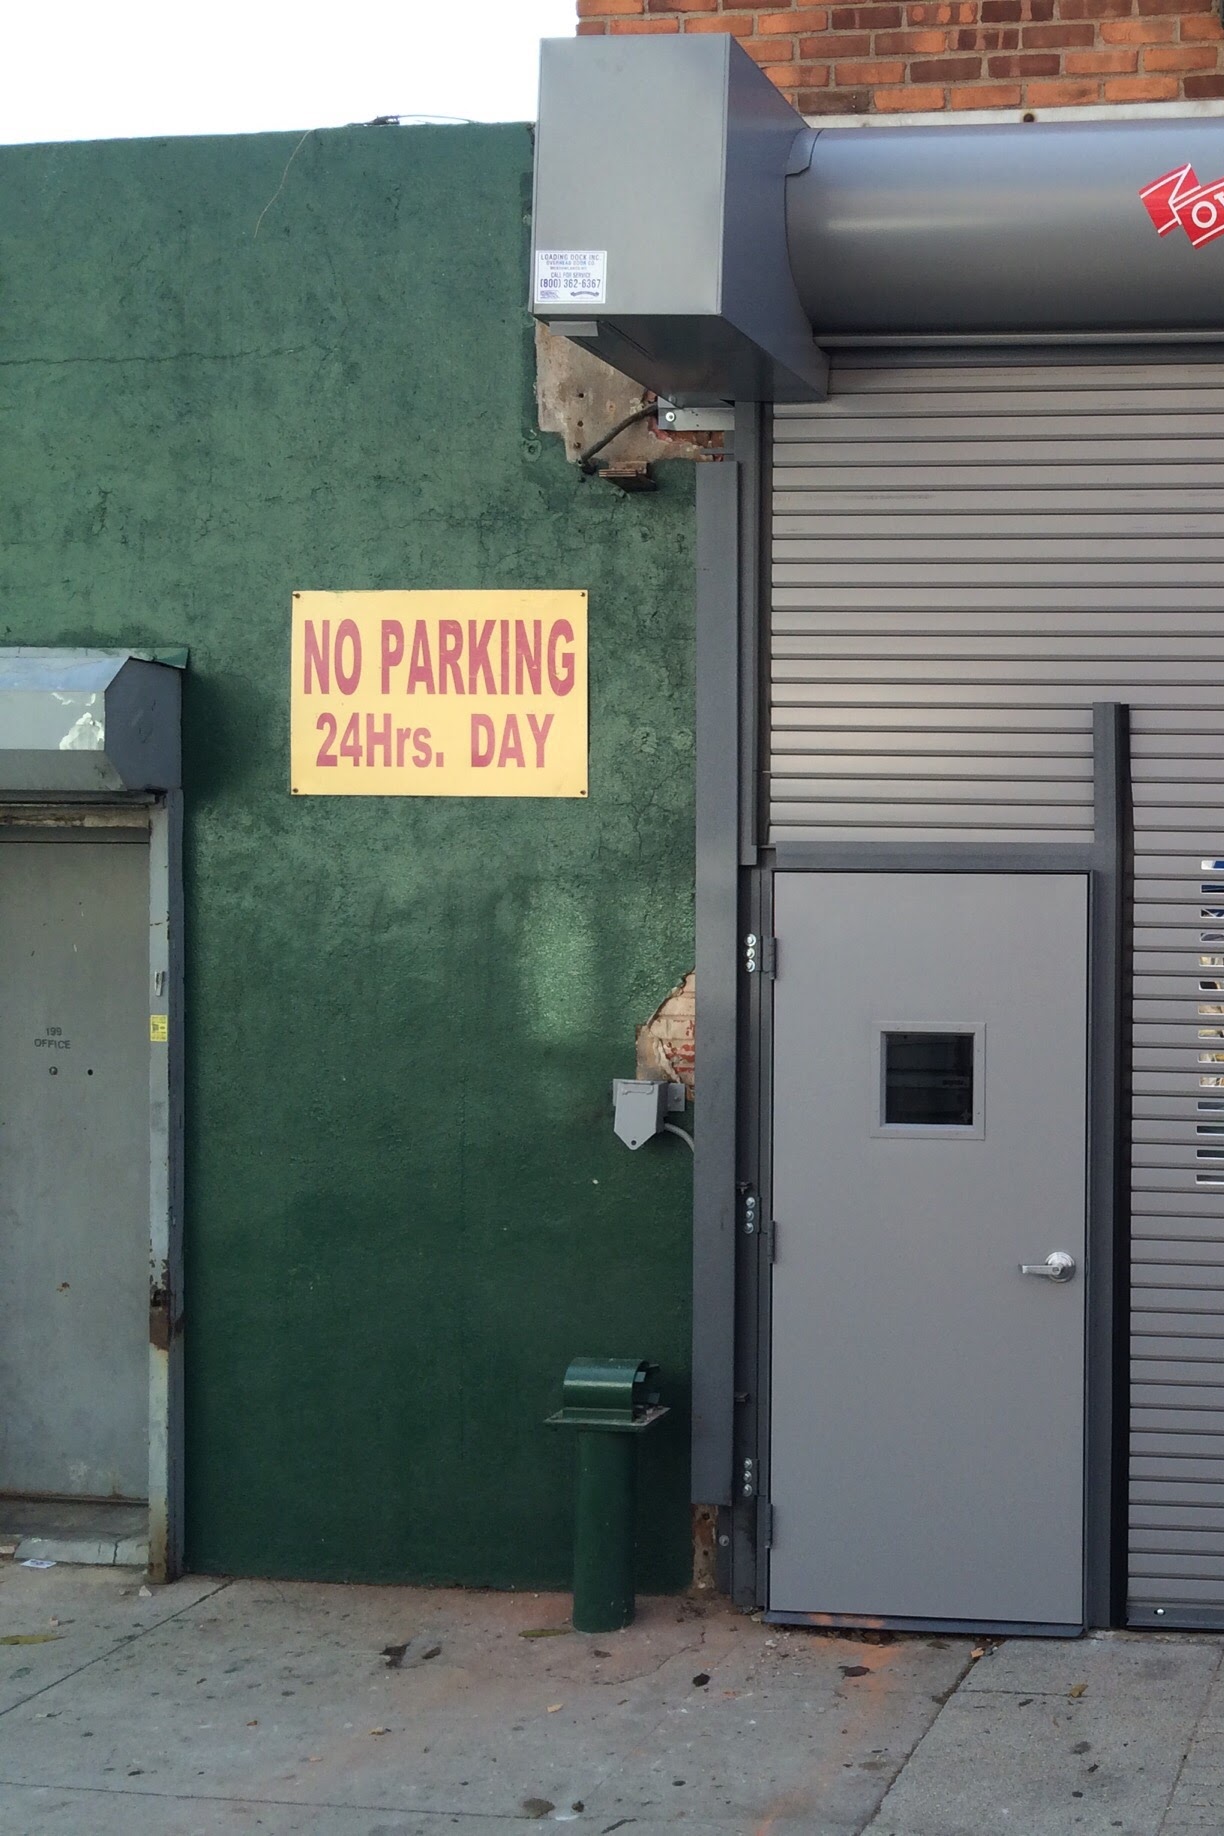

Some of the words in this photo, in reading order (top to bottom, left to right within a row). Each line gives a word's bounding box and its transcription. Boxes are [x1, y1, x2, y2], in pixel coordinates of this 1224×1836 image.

[540, 279, 562, 288] (800)
[564, 279, 601, 288] 362-6367
[303, 618, 362, 696] NO
[381, 618, 576, 697] PARKING
[315, 712, 445, 768] 24Hrs.
[470, 713, 555, 768] DAY
[46, 1027, 62, 1036] 199
[34, 1038, 72, 1049] OFFICE
